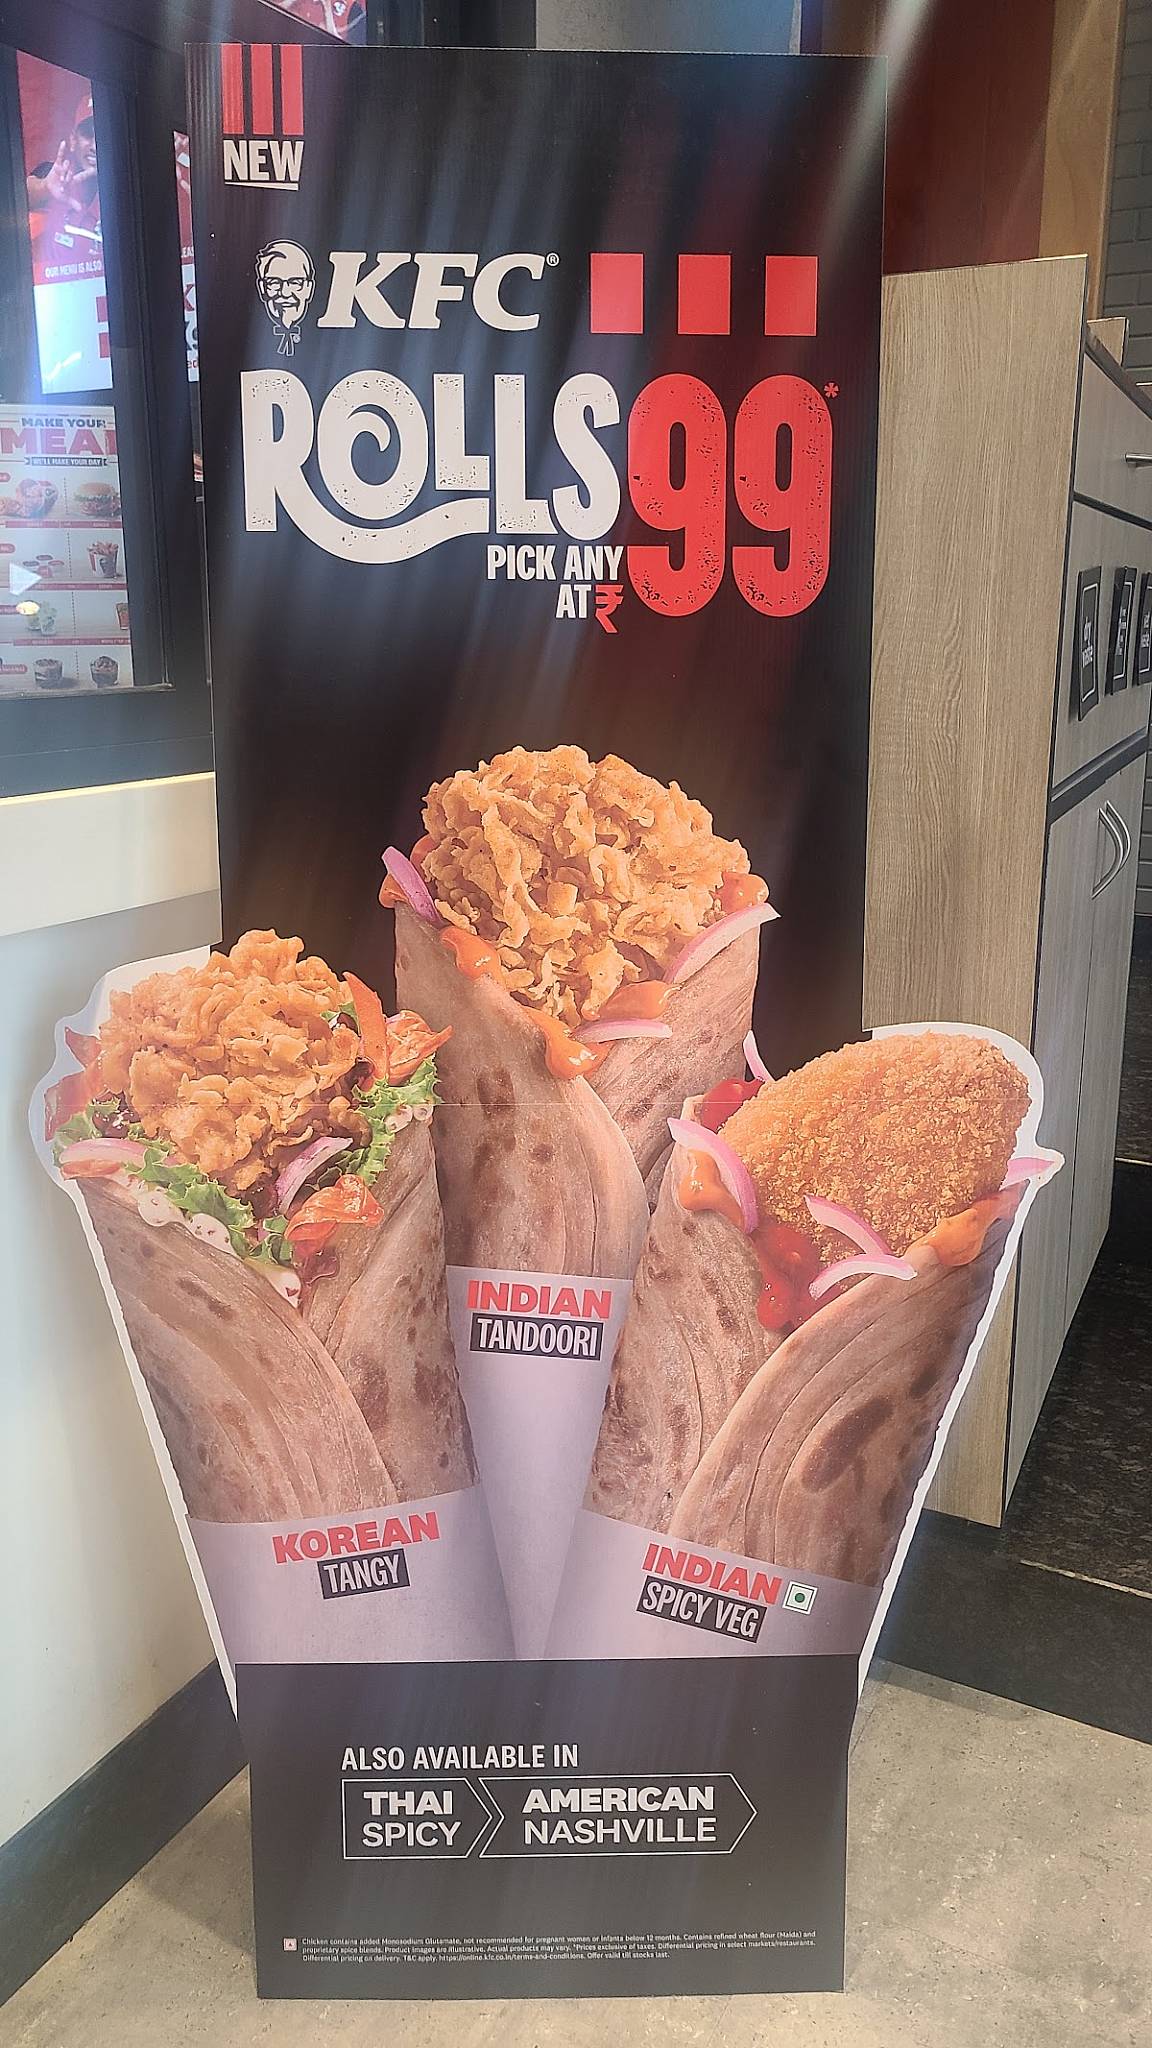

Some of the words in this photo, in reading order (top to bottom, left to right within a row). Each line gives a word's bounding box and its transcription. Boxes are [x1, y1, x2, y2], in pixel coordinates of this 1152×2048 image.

[223, 139, 305, 182] NEW
[86, 261, 102, 273] ALSO
[21, 418, 63, 427] MAKE
[67, 418, 106, 428] YOUR
[52, 458, 69, 466] MAKE
[71, 458, 88, 466] YOUR
[89, 458, 101, 466] DAY
[240, 369, 621, 564] ROLLS
[487, 546, 557, 581] PICK
[563, 547, 624, 581] ANY
[467, 1279, 612, 1320] INDIAN
[477, 1318, 598, 1357] TANDOORI
[271, 1511, 440, 1564] KOREAN
[323, 1554, 399, 1593] TANGY
[642, 1543, 783, 1605] INDIAN
[642, 1581, 713, 1625] SPICY
[715, 1599, 760, 1638] VEG
[341, 1747, 405, 1770] ALSO
[412, 1744, 546, 1769] AVAILABLE
[552, 1744, 579, 1768] IN
[363, 1790, 454, 1815] THAI
[521, 1785, 715, 1814] AMERICAN
[361, 1821, 462, 1848] SPICY
[523, 1817, 717, 1845] NASHVILLE
[303, 1947, 339, 1955] proprietary
[510, 1945, 539, 1953] products
[696, 1942, 718, 1950] pricing
[536, 1936, 565, 1944] pregnant
[777, 1931, 801, 1940] (Maida)
[341, 1955, 363, 1963] pricing
[374, 1955, 400, 1963] delivery.
[419, 1955, 437, 1963] apply.
